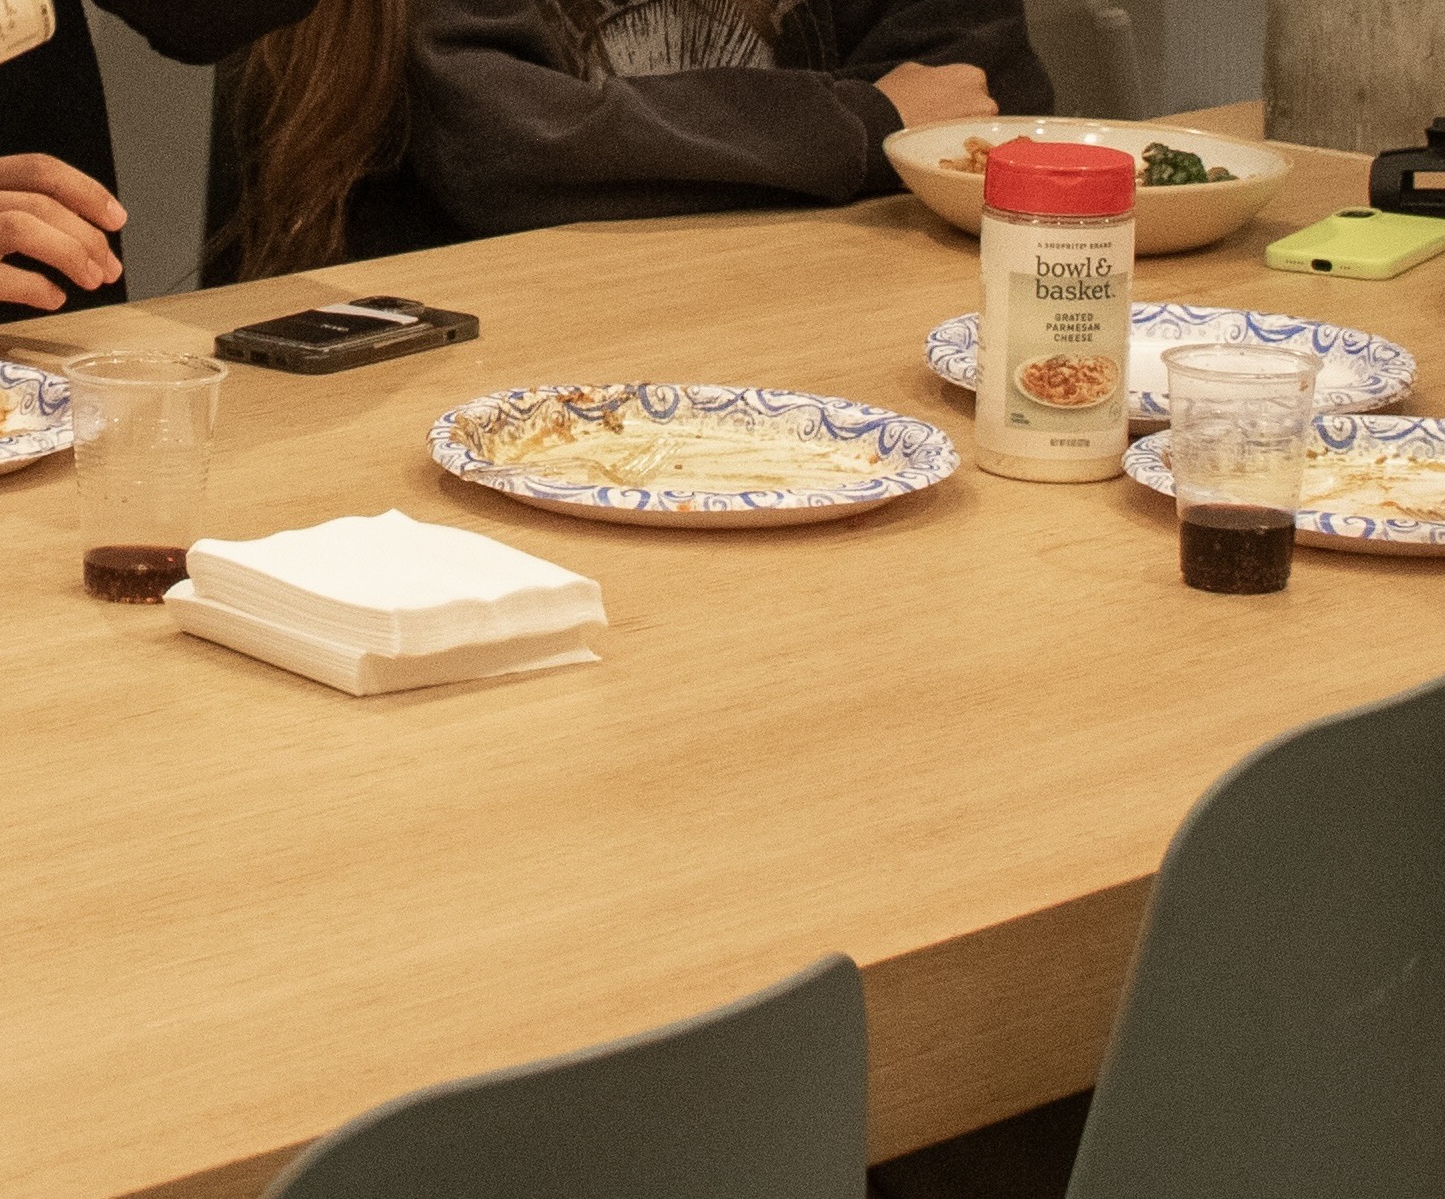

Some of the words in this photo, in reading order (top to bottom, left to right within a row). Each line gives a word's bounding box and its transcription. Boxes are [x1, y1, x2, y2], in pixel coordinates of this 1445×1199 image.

[1036, 255, 1092, 278] bowl
[1095, 258, 1113, 277] &
[1035, 278, 1112, 301] basket
[1054, 313, 1094, 322] GRATED
[1046, 323, 1101, 332] PARMESAN
[1054, 333, 1094, 343] CHEESE
